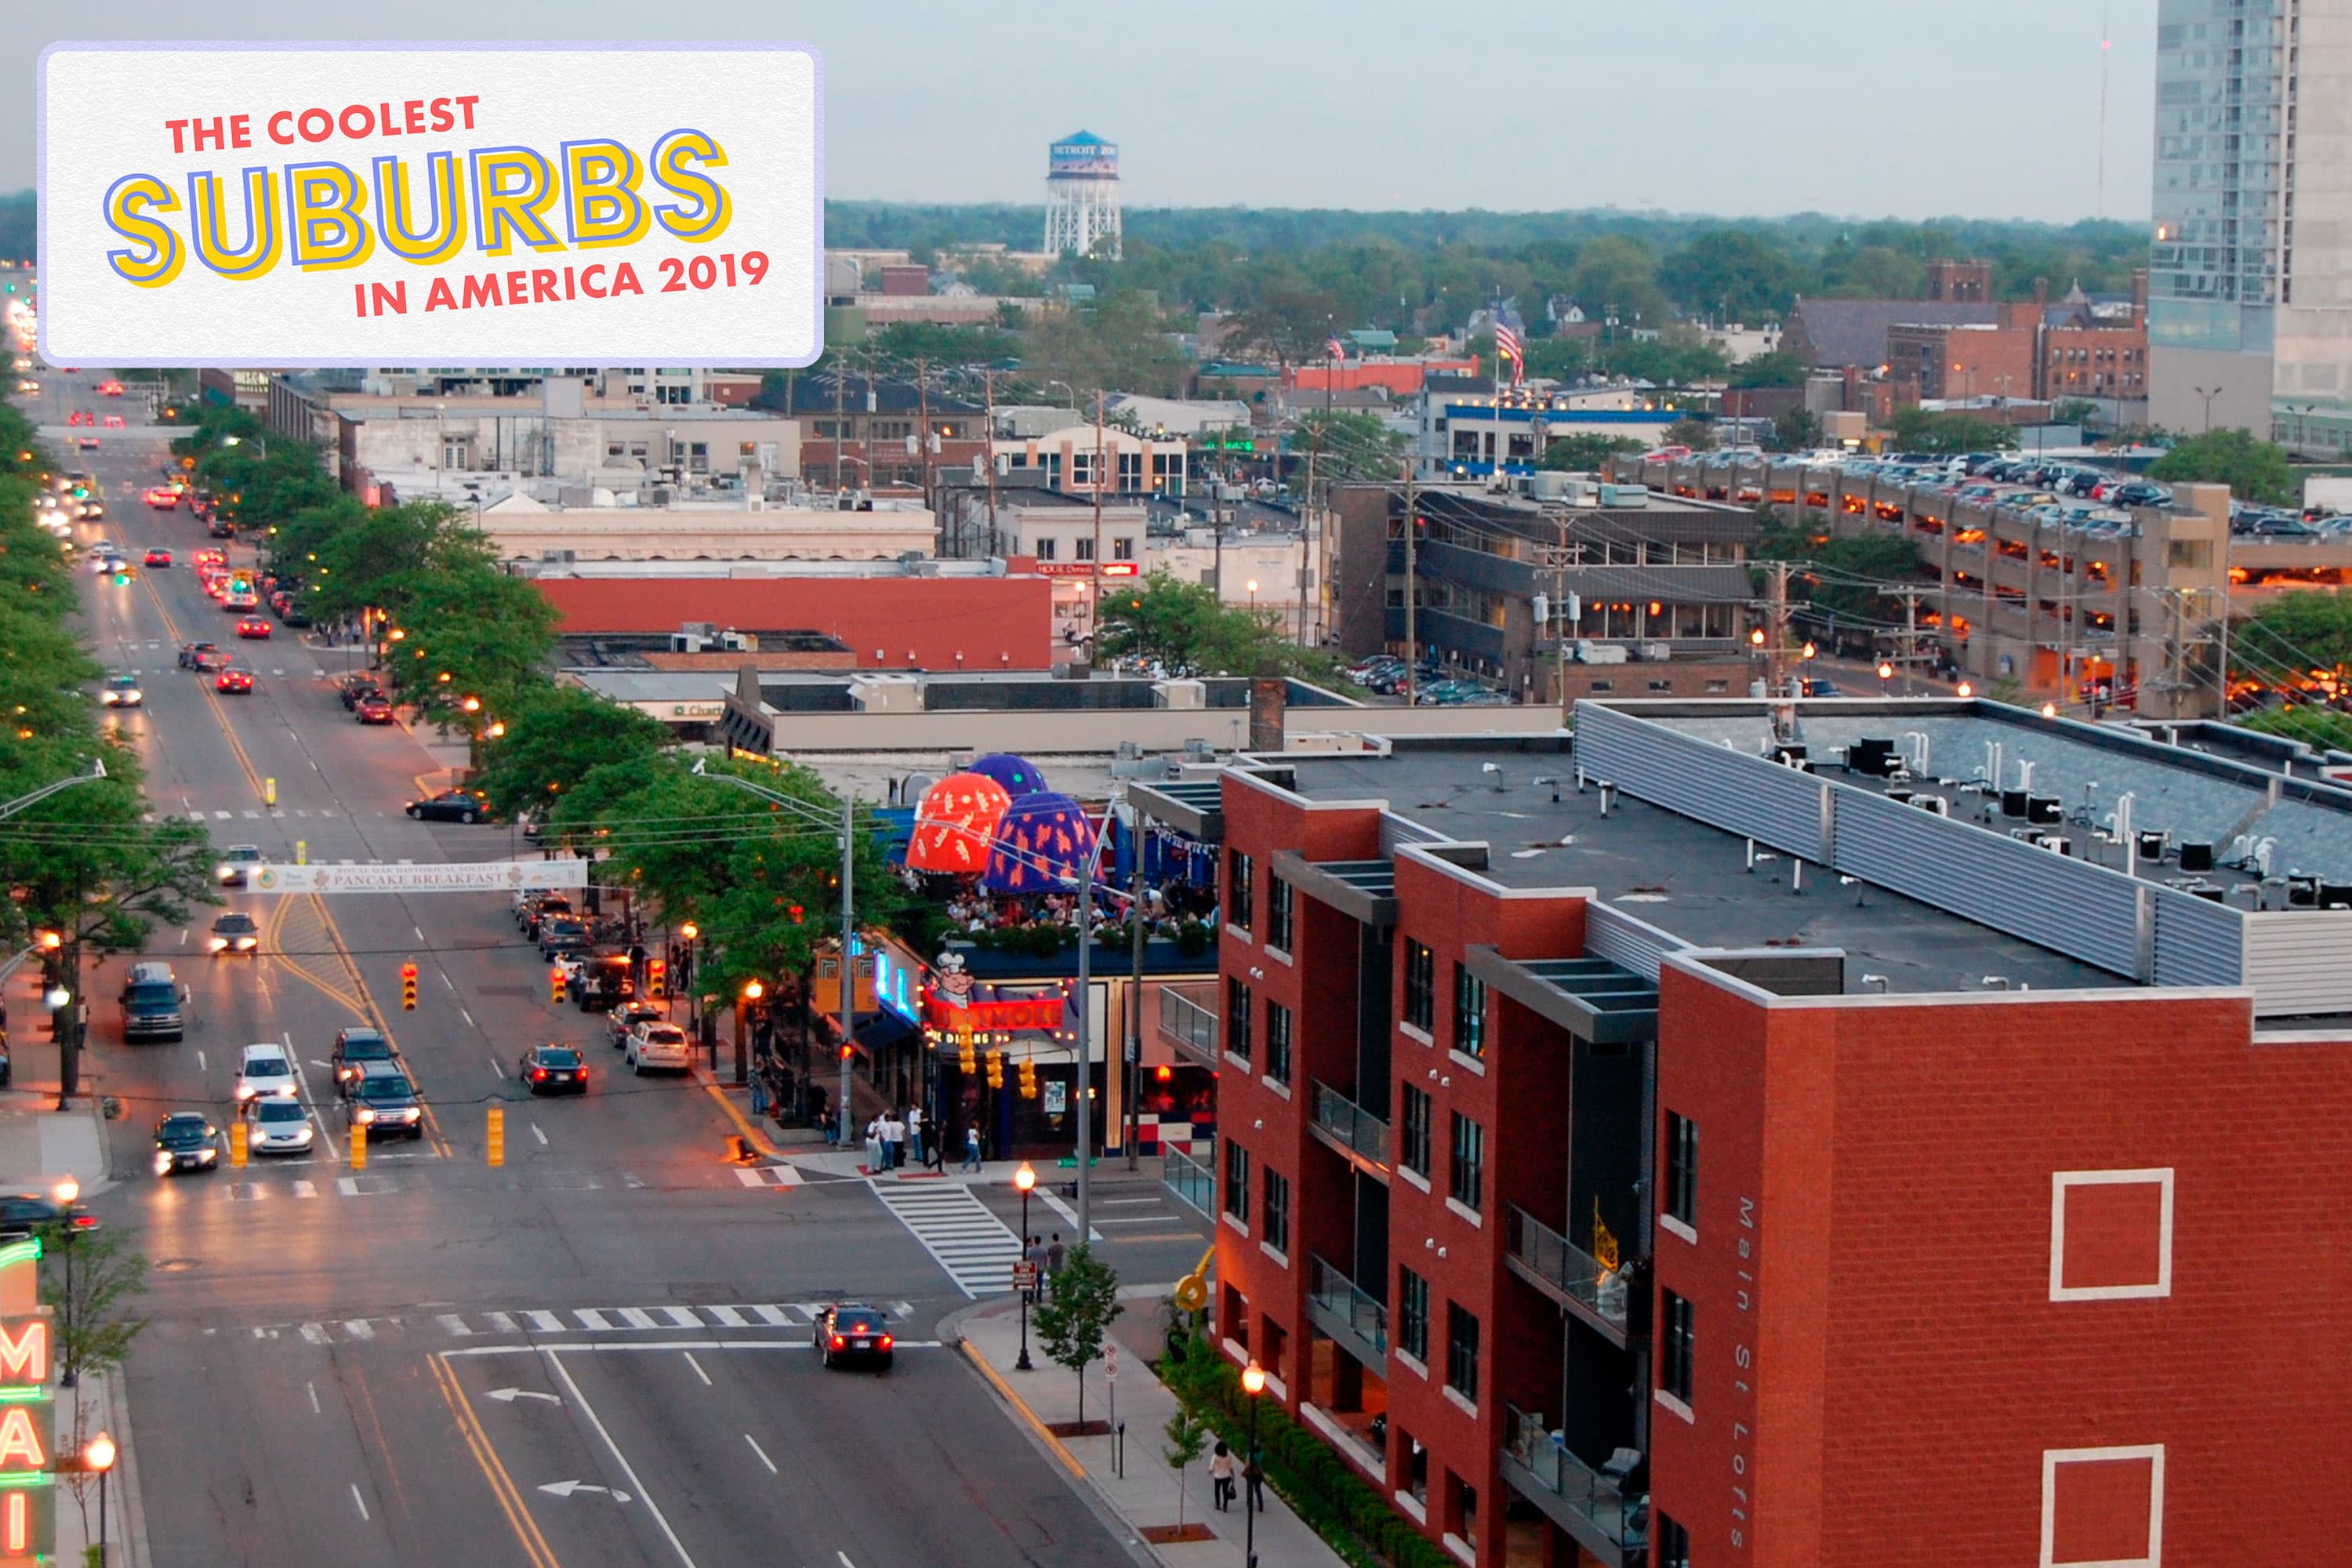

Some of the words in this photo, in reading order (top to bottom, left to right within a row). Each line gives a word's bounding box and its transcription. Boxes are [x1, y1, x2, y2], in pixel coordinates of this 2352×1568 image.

[335, 875, 408, 885] PANCAKE
[413, 873, 502, 884] BREAKFAST
[1737, 1196, 1754, 1311] Main
[1735, 1343, 1751, 1392] St
[1730, 1422, 1748, 1548] Lofts
